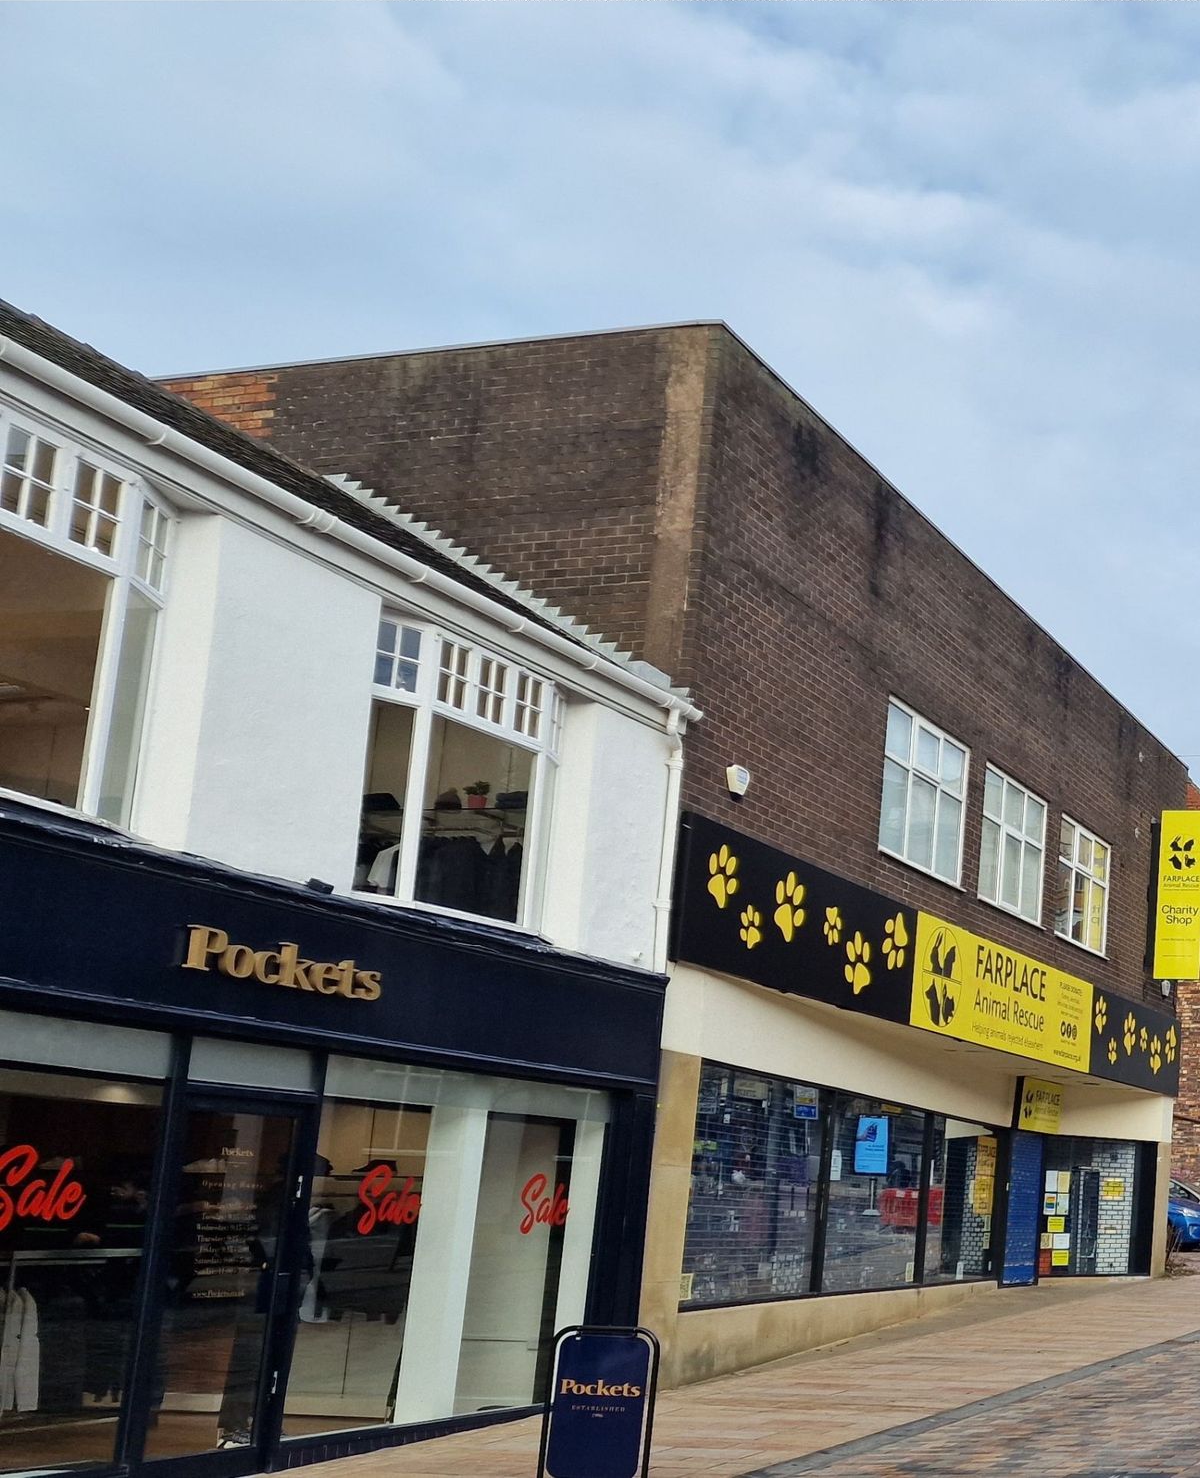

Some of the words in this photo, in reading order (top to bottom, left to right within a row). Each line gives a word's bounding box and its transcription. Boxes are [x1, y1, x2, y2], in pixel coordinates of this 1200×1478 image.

[1162, 875, 1200, 883] FARPLACE
[1161, 904, 1199, 917] Charity
[1165, 915, 1193, 926] Shop
[180, 924, 382, 1002] Pockets
[975, 944, 1047, 1003] FARPLACE
[973, 988, 1011, 1023] Animal
[1013, 1000, 1045, 1033] Rescue
[221, 1147, 254, 1158] Pockets
[0, 1144, 87, 1232] Sale
[356, 1164, 423, 1235] Sale
[519, 1173, 571, 1234] Sale
[560, 1378, 641, 1398] Pockets
[571, 1405, 626, 1413] ESTABLISHED
